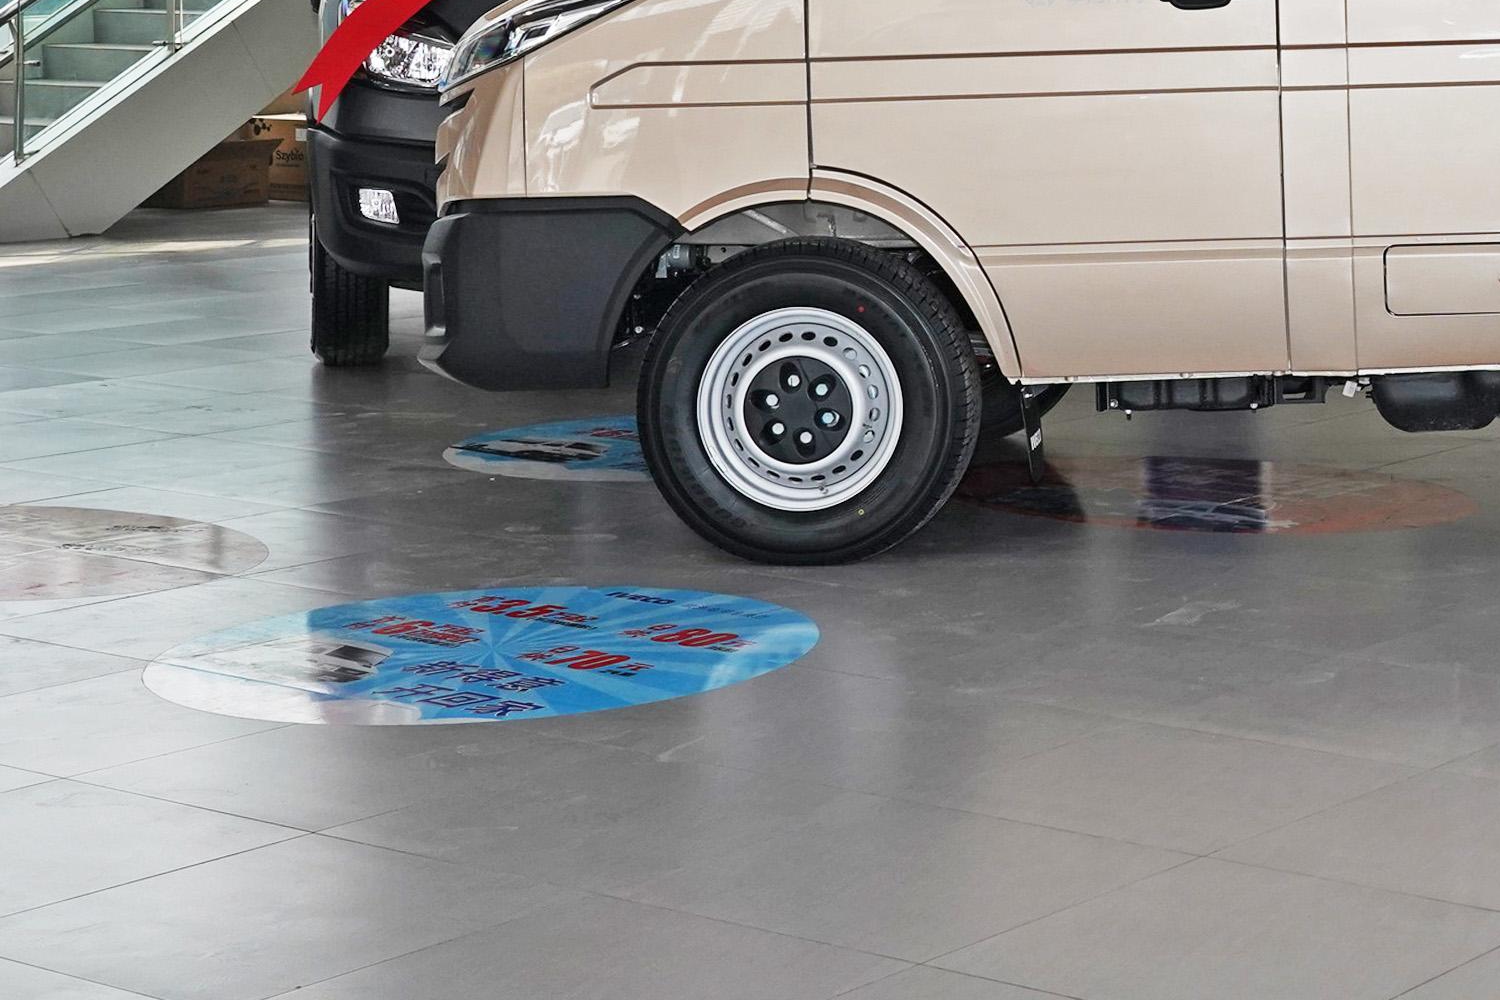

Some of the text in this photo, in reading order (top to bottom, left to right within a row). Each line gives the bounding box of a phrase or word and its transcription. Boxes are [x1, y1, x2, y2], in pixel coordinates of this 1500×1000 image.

[605, 591, 678, 606] IVECO
[401, 660, 570, 693] 新得意
[371, 683, 545, 717] 开回家
